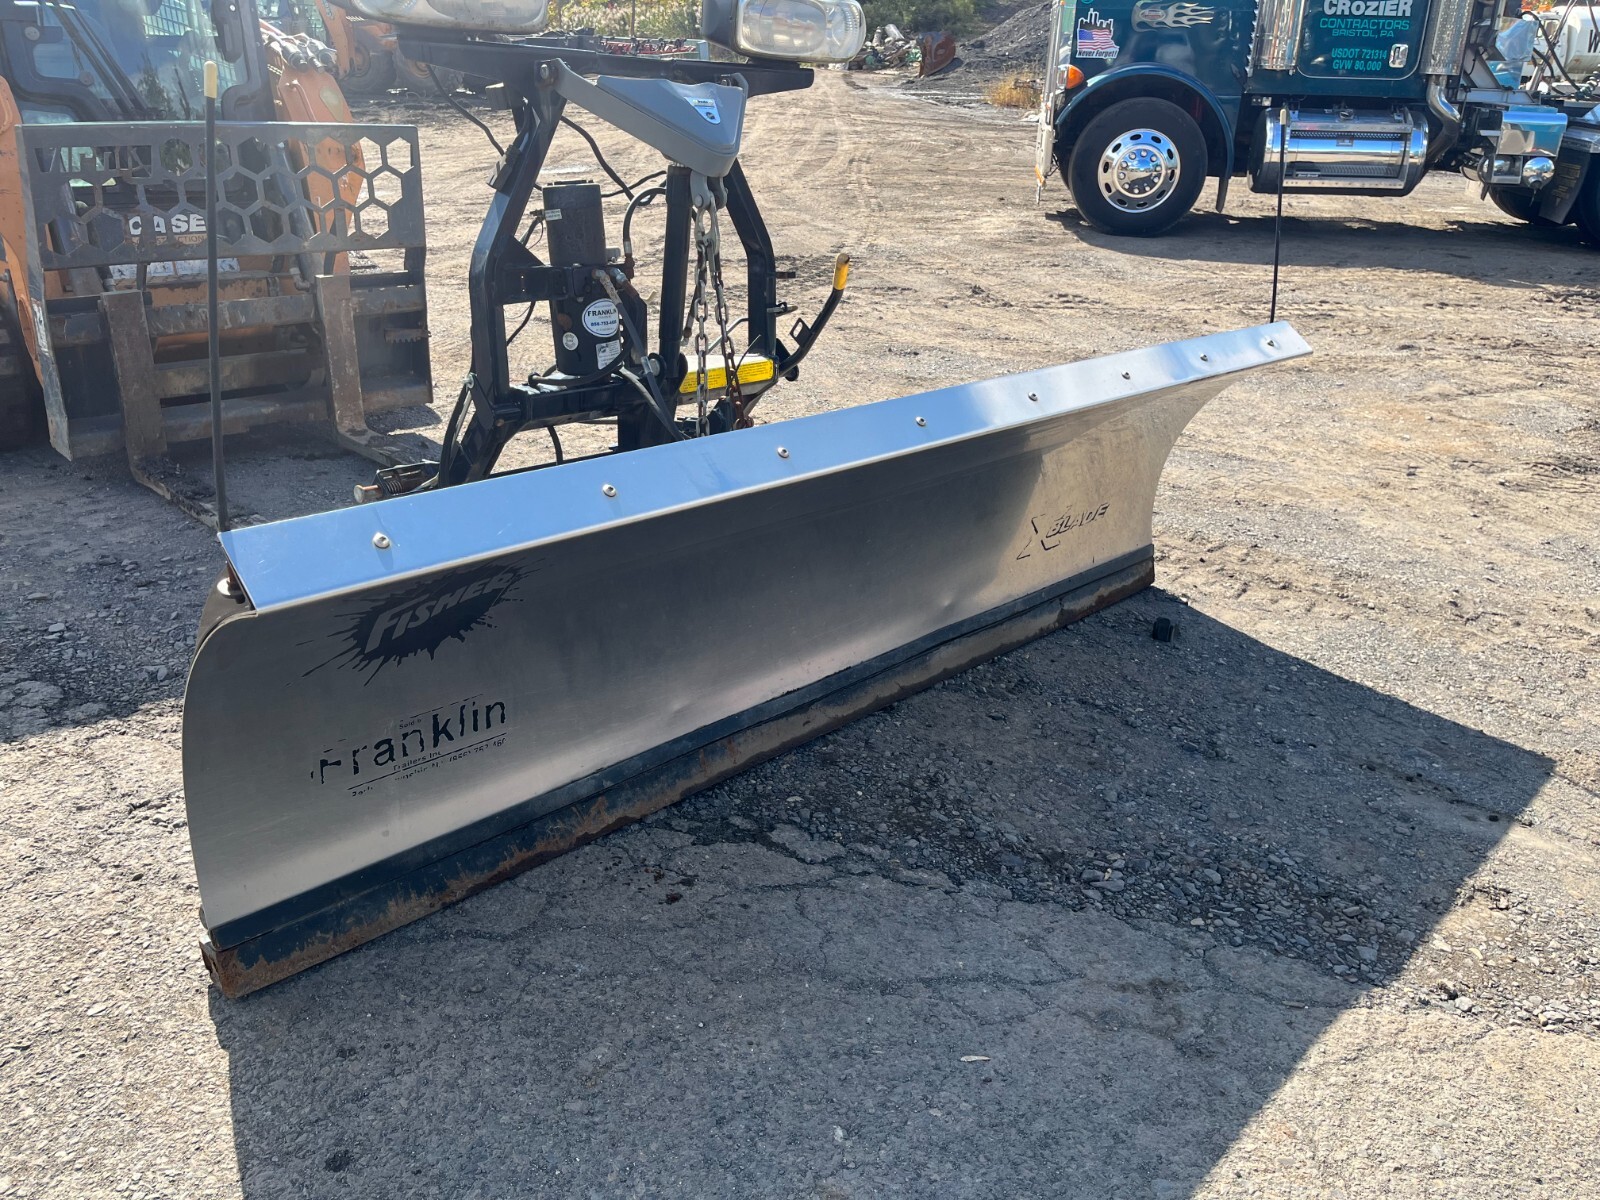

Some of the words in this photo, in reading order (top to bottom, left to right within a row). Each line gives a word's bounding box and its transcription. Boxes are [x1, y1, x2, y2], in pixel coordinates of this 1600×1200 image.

[1323, 0, 1412, 16] CROZIER
[1319, 18, 1410, 30] CONTRACTORS
[1332, 29, 1378, 38] BRISTOL,
[1078, 49, 1095, 57] Never
[1095, 49, 1117, 58] Forget!
[1331, 47, 1360, 58] USDOT
[1361, 49, 1388, 59] 721314
[1332, 59, 1353, 70] GVW
[1354, 60, 1382, 71] 80,000
[128, 213, 207, 236] CASE
[364, 572, 510, 653] FISHER
[319, 701, 506, 784] Franklin
